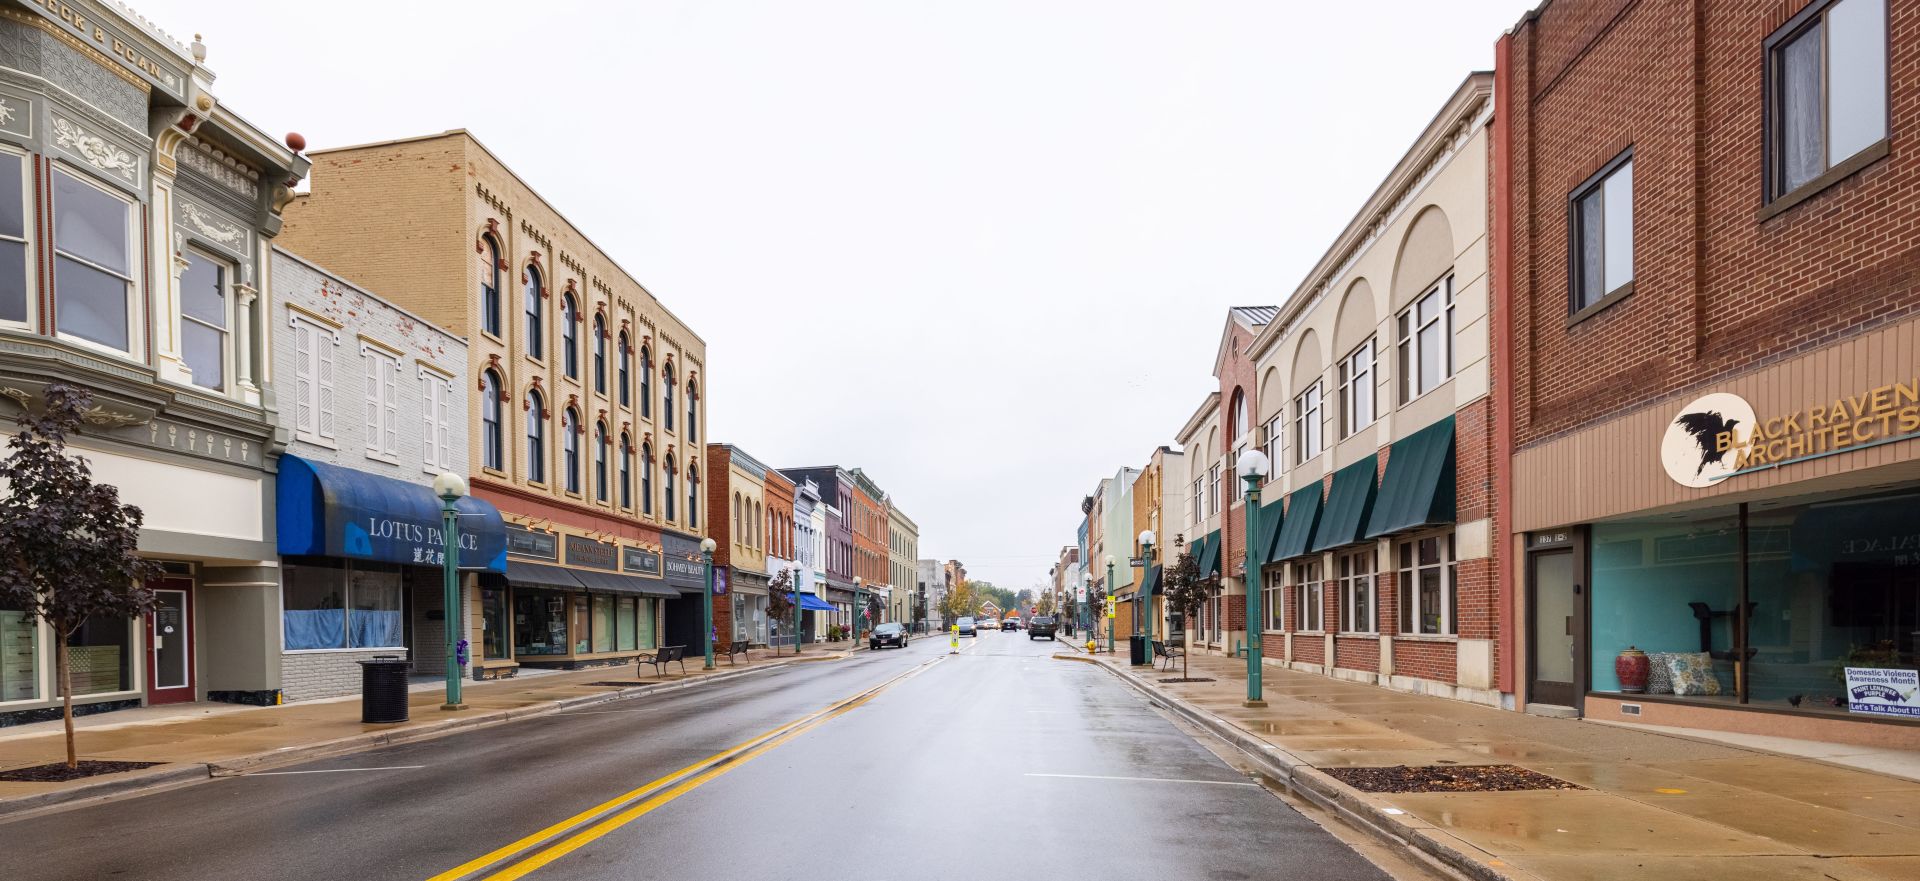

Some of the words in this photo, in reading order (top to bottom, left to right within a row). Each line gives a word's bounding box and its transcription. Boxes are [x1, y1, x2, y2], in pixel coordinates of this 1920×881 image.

[95, 27, 105, 43] &
[113, 39, 161, 79] EGAN
[1715, 411, 1804, 453] BLACK
[1807, 377, 1920, 428] RAVEN
[1733, 406, 1920, 470] ARCHITECTS
[369, 517, 423, 543] LOTUS
[688, 563, 705, 576] BEAUTY
[1853, 686, 1869, 694] PAINT
[1869, 685, 1897, 697] LENAWEE
